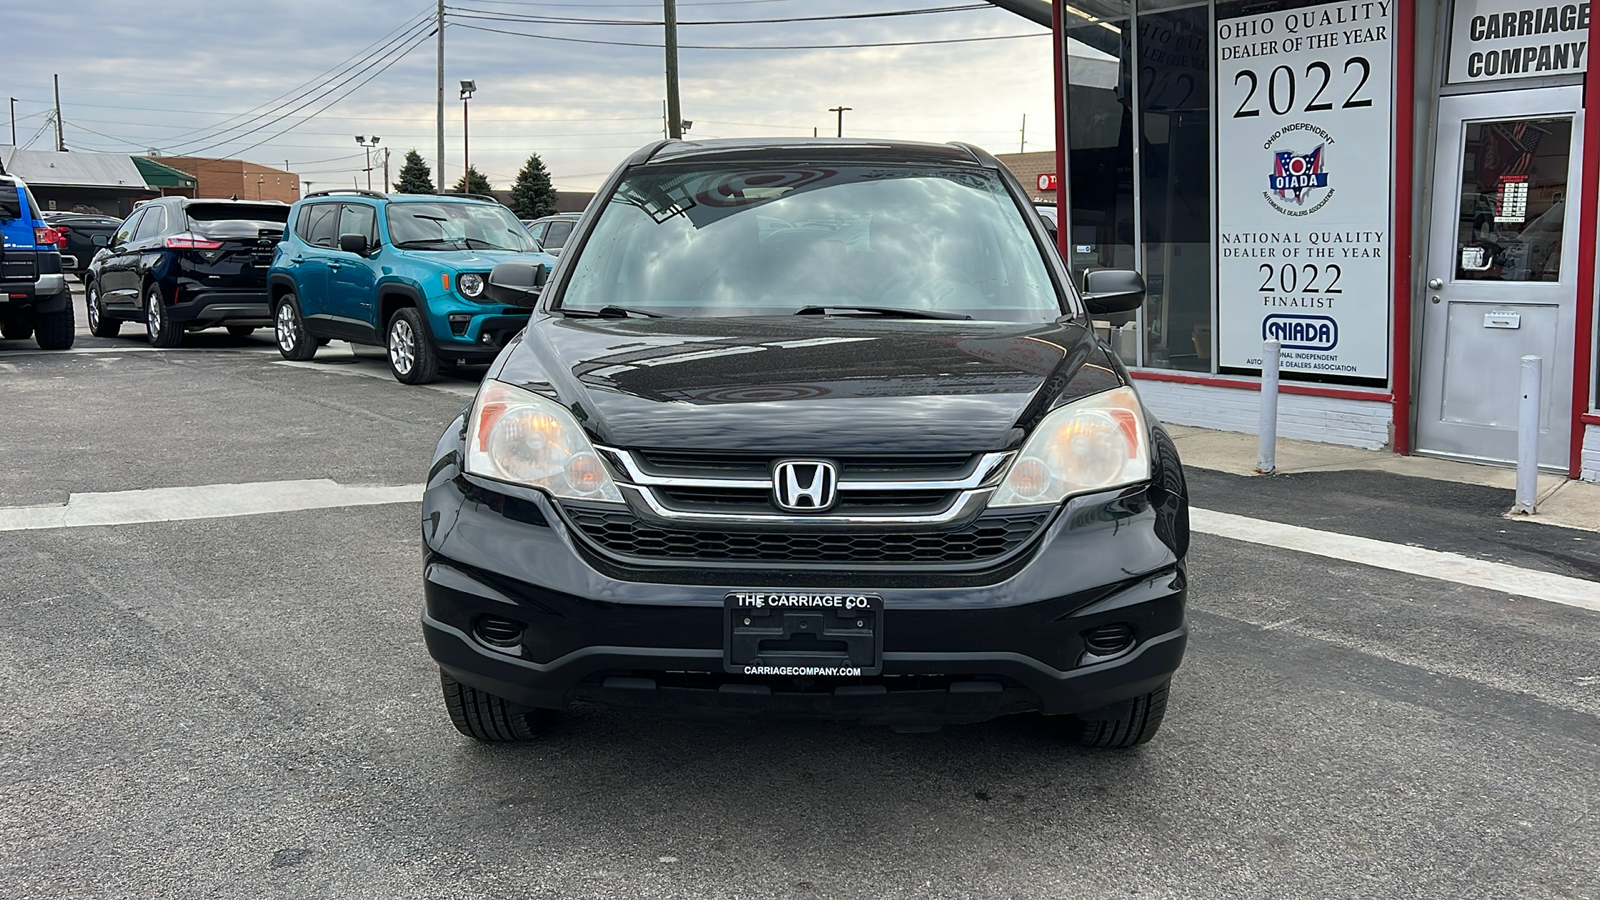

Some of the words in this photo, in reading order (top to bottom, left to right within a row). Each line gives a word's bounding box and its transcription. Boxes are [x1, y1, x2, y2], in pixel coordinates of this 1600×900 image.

[1219, 17, 1274, 40] OHIO
[1285, 0, 1390, 34] QUALITY
[1470, 3, 1590, 42] CARRIAGE
[1221, 40, 1279, 61] DEALER
[1282, 37, 1303, 53] OF
[1306, 32, 1339, 50] THE
[1343, 26, 1387, 45] YEAR
[1467, 41, 1587, 78] COMPANY
[1233, 56, 1373, 119] 2022
[1264, 130, 1281, 150] OHIO
[1281, 122, 1335, 146] INDEPENDENT
[1276, 174, 1318, 189] OIADA
[1262, 191, 1287, 215] AUTOMOBILE
[1286, 209, 1309, 217] DEALERS
[1308, 187, 1335, 214] ASSOCIATION
[1222, 232, 1301, 244] NATIONAL
[1309, 231, 1384, 245] QUALITY
[1223, 247, 1276, 258] DEALER
[1282, 247, 1300, 258] OF
[1307, 247, 1335, 258] THE
[1342, 247, 1382, 258] YEAR
[1258, 263, 1343, 294] 2022
[1264, 296, 1335, 309] FINALIST
[1268, 321, 1331, 343] NIADA
[1285, 361, 1312, 369] DEALERS
[1313, 363, 1357, 372] ASSOCIATION
[1295, 353, 1338, 361] INDEPENDENT
[736, 594, 766, 607] THE
[768, 595, 843, 607] CARRIAGE
[846, 596, 871, 609] CO.
[744, 666, 861, 676] CARRIAGECOMPANY.COM
